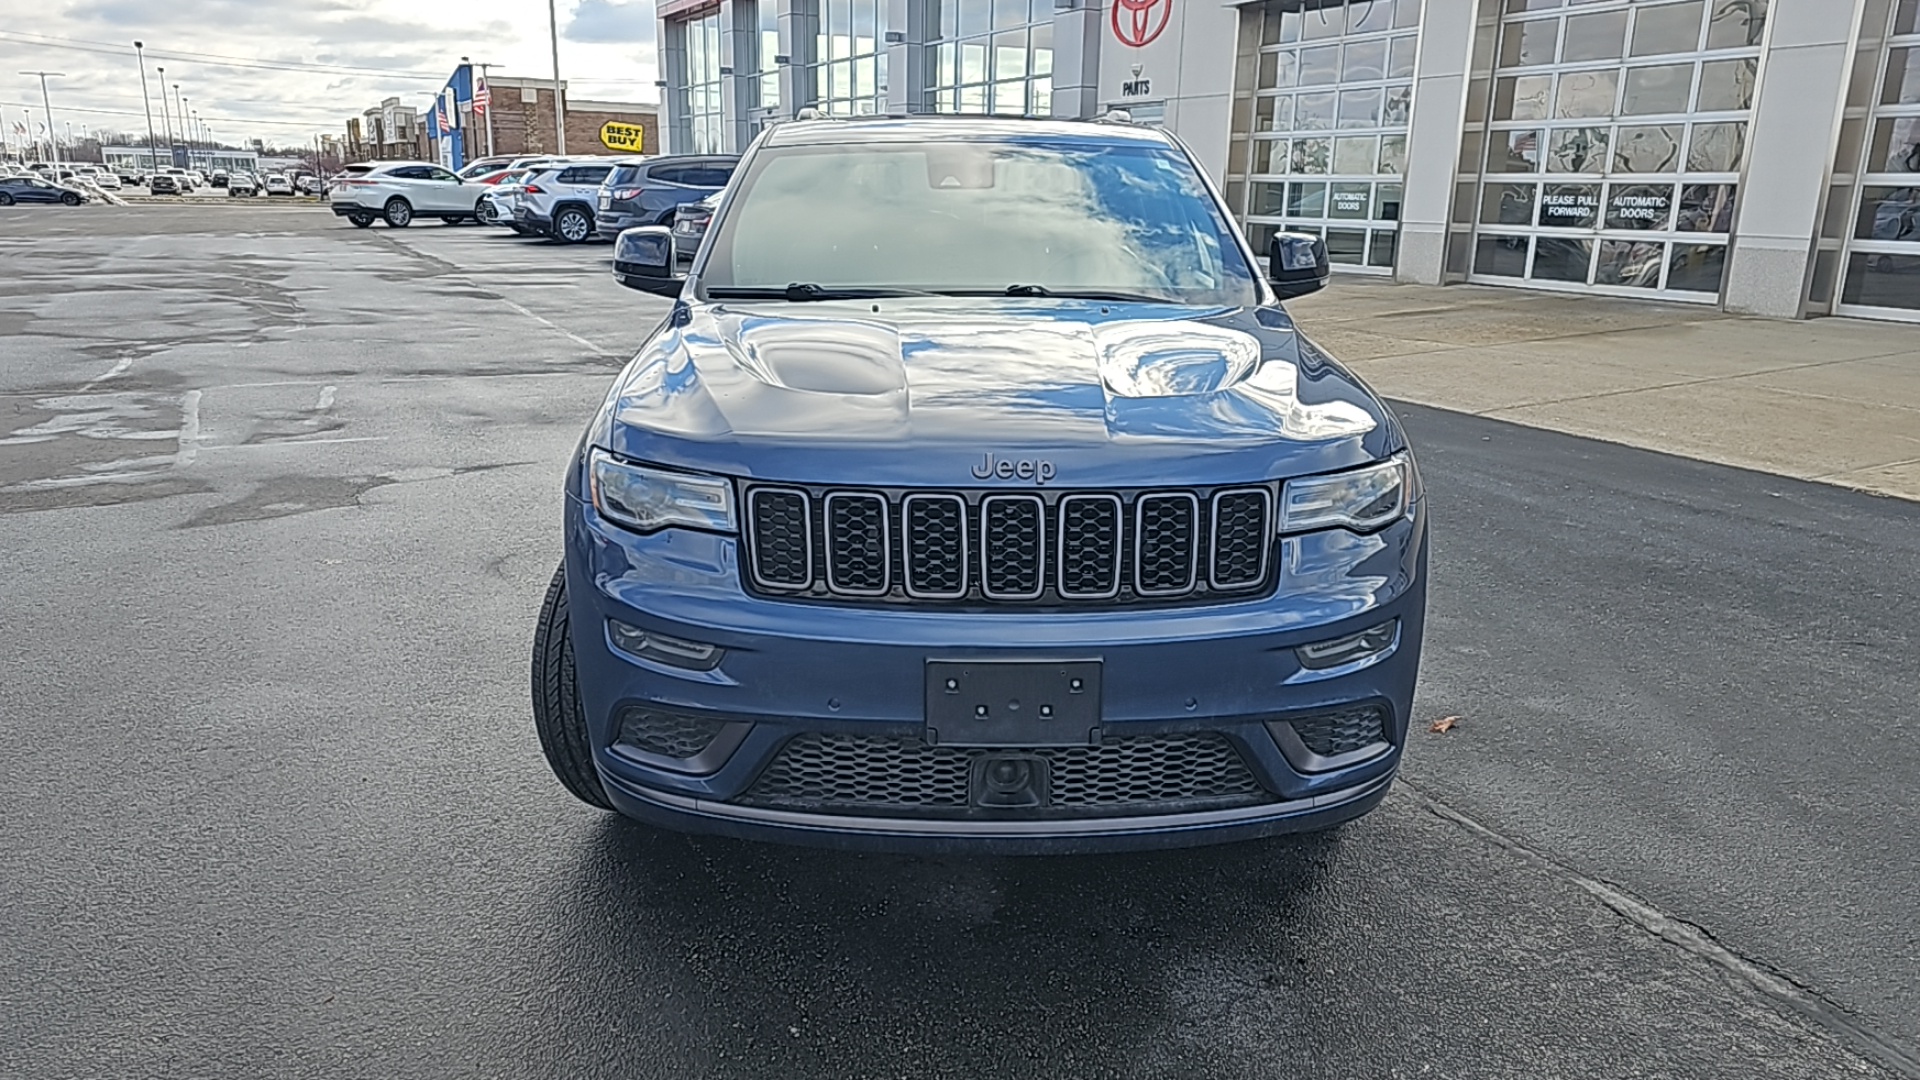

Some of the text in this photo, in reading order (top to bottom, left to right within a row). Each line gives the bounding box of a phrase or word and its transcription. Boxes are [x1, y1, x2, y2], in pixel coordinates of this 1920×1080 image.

[1122, 80, 1150, 97] PARTS
[606, 125, 641, 137] BEST
[607, 135, 637, 146] BUY
[1332, 192, 1368, 201] AUTOMATIC
[1543, 194, 1599, 206] PLEASE PULL
[1612, 196, 1667, 207] AUTOMATIC
[1337, 201, 1360, 211] DOORS
[1547, 206, 1591, 217] FORWARD
[1620, 208, 1655, 219] DOORS
[970, 452, 1057, 485] Jeep
